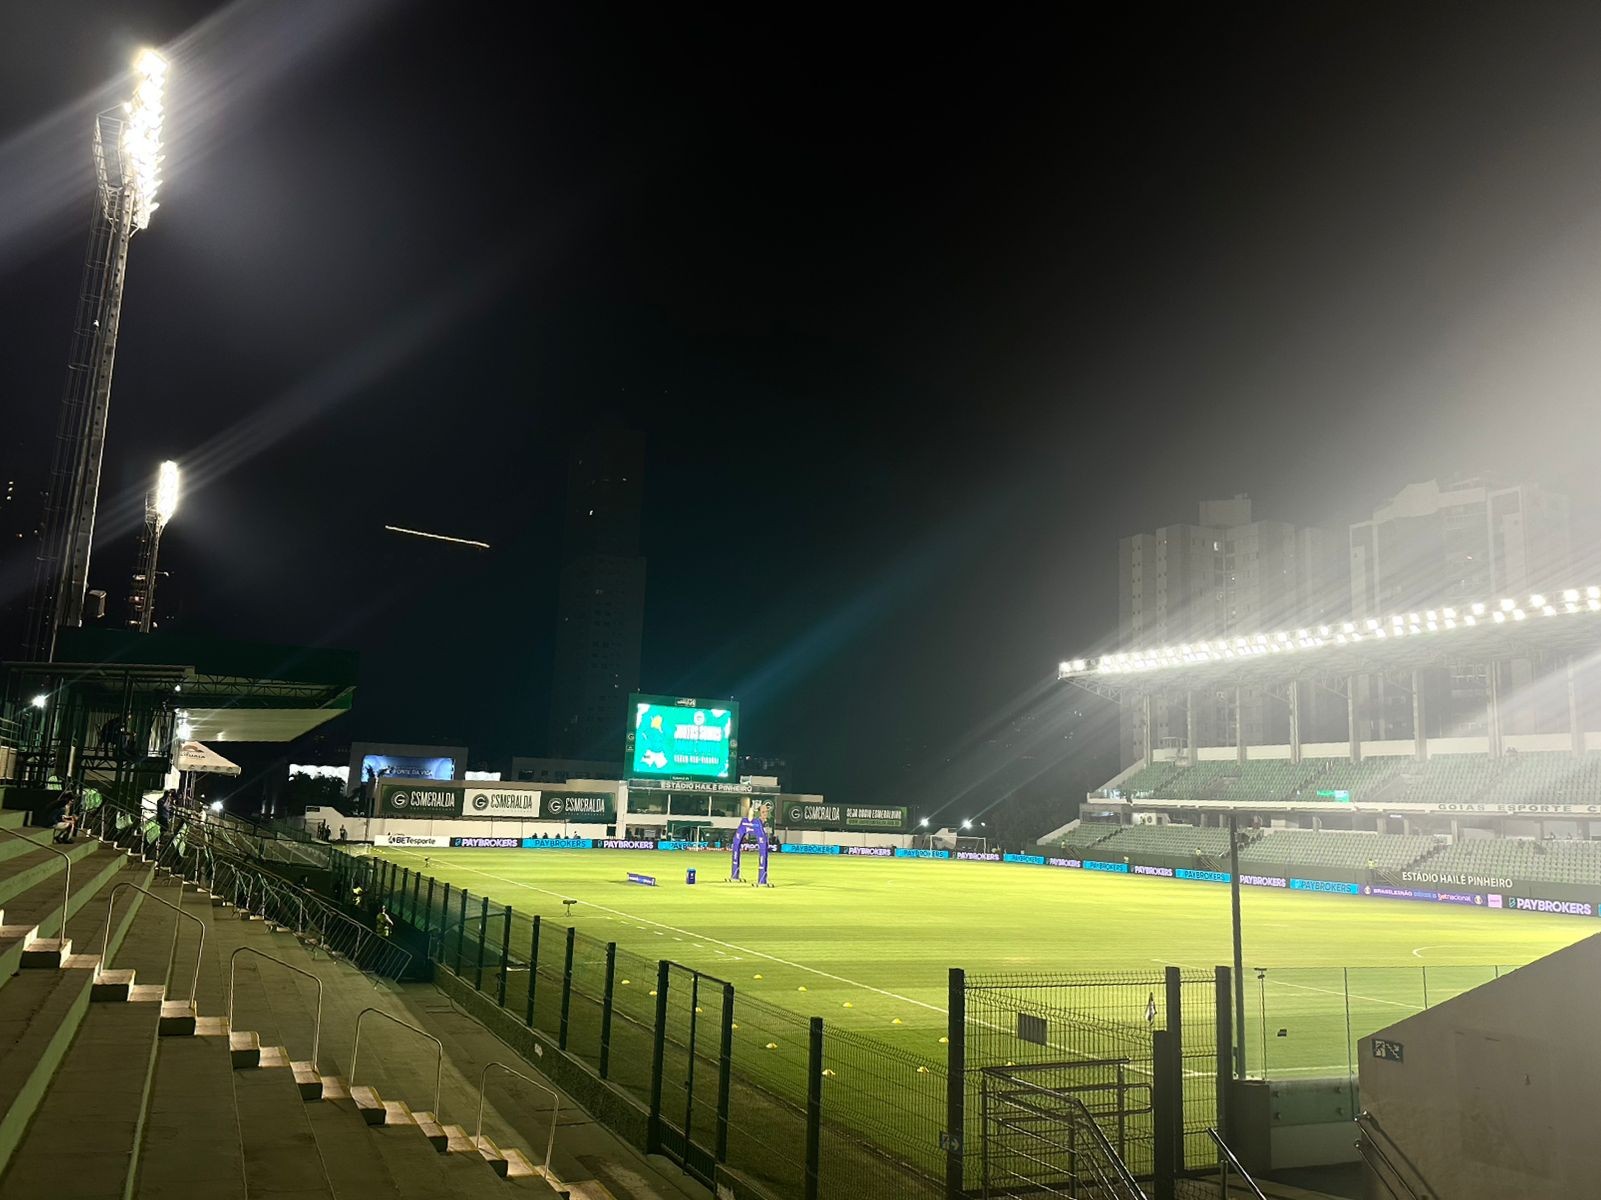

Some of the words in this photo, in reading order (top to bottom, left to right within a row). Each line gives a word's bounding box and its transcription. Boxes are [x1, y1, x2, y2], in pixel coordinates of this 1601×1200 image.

[410, 791, 455, 808] ESMERALDA
[490, 794, 532, 809] ESMERALDA
[565, 798, 605, 813] ESMERALDA
[804, 806, 840, 821] ESMERALDA
[1497, 804, 1572, 812] ESPORTE
[461, 838, 518, 848] PAYBROKERS
[535, 839, 586, 848] PAYBROKERS
[603, 840, 654, 849] PAYBROKERS
[791, 845, 834, 854] PAYBROKERS
[848, 847, 891, 856] PAYBROKERS
[957, 851, 1000, 861] PAYBROKERS
[1134, 865, 1173, 876] PAYBROKERS
[1184, 869, 1225, 881] PAYBROKERS
[1239, 874, 1286, 888] PAYBROKERS
[1402, 871, 1439, 883] ESTÁDIO
[1440, 873, 1467, 885] HAILÉ
[1467, 877, 1513, 889] PINHEIRO
[1301, 880, 1351, 893] PAYBROKERS
[1516, 898, 1592, 915] PAYBROKERS
